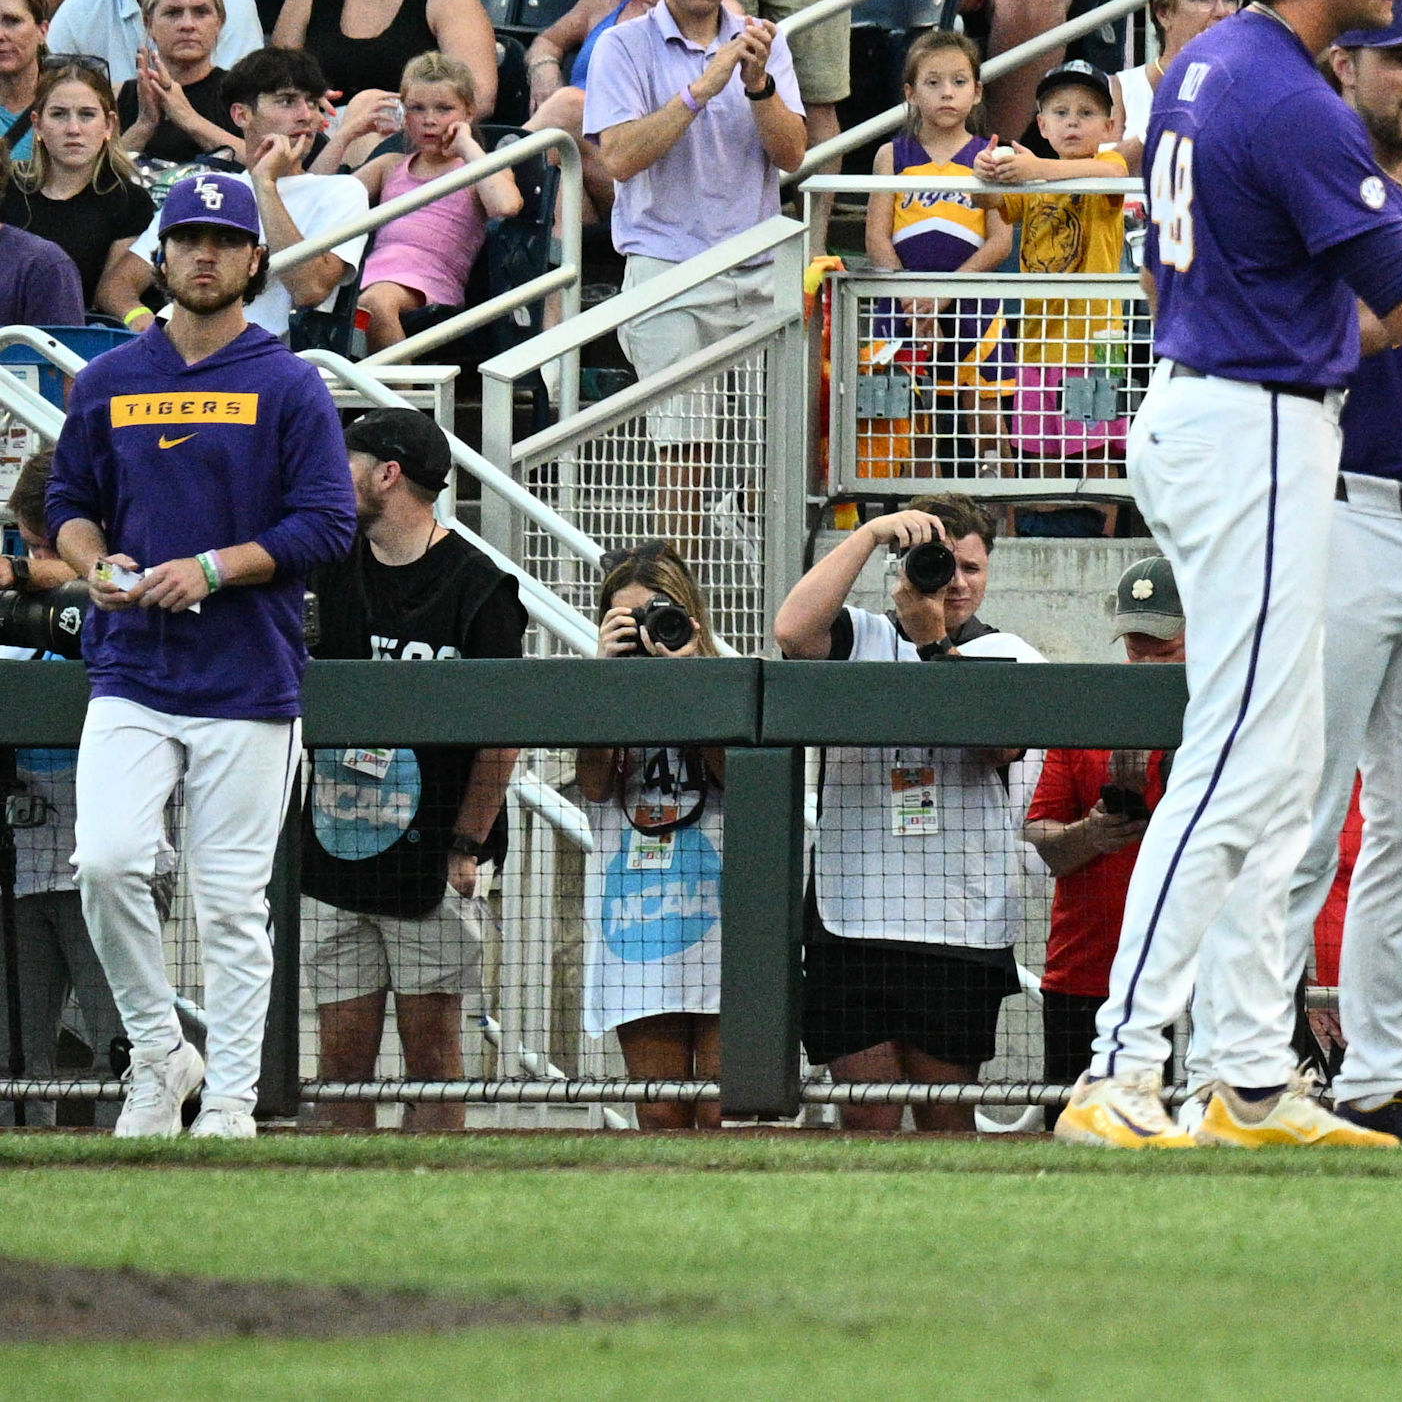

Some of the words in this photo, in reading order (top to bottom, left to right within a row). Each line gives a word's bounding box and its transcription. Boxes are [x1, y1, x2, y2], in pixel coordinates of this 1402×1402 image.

[193, 176, 224, 211] LSU
[1150, 128, 1195, 273] 48
[125, 400, 243, 417] TIGERS
